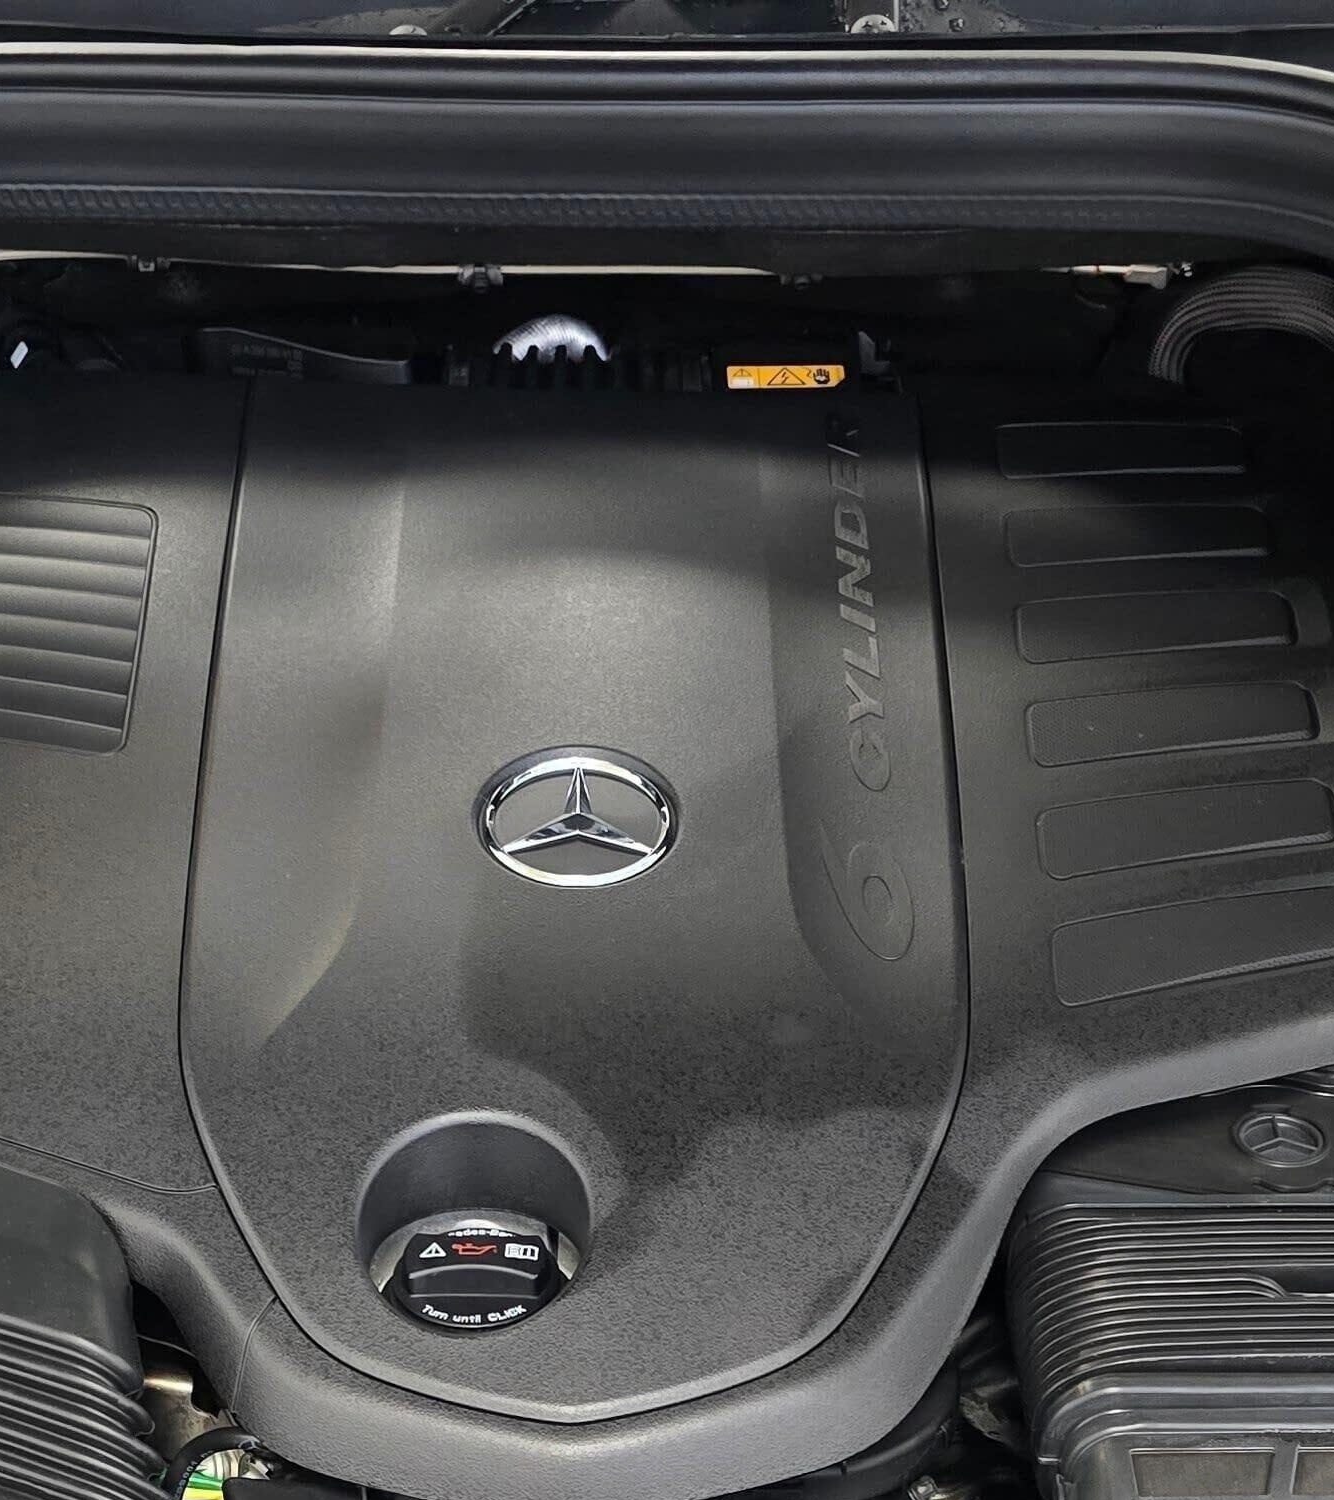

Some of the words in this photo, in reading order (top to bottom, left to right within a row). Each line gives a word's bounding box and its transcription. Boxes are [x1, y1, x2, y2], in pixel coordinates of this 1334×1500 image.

[825, 411, 891, 792] CYLINDER
[818, 818, 915, 961] 6
[422, 1304, 449, 1320] Turn
[452, 1314, 482, 1323] until
[487, 1304, 527, 1322] CLICK
